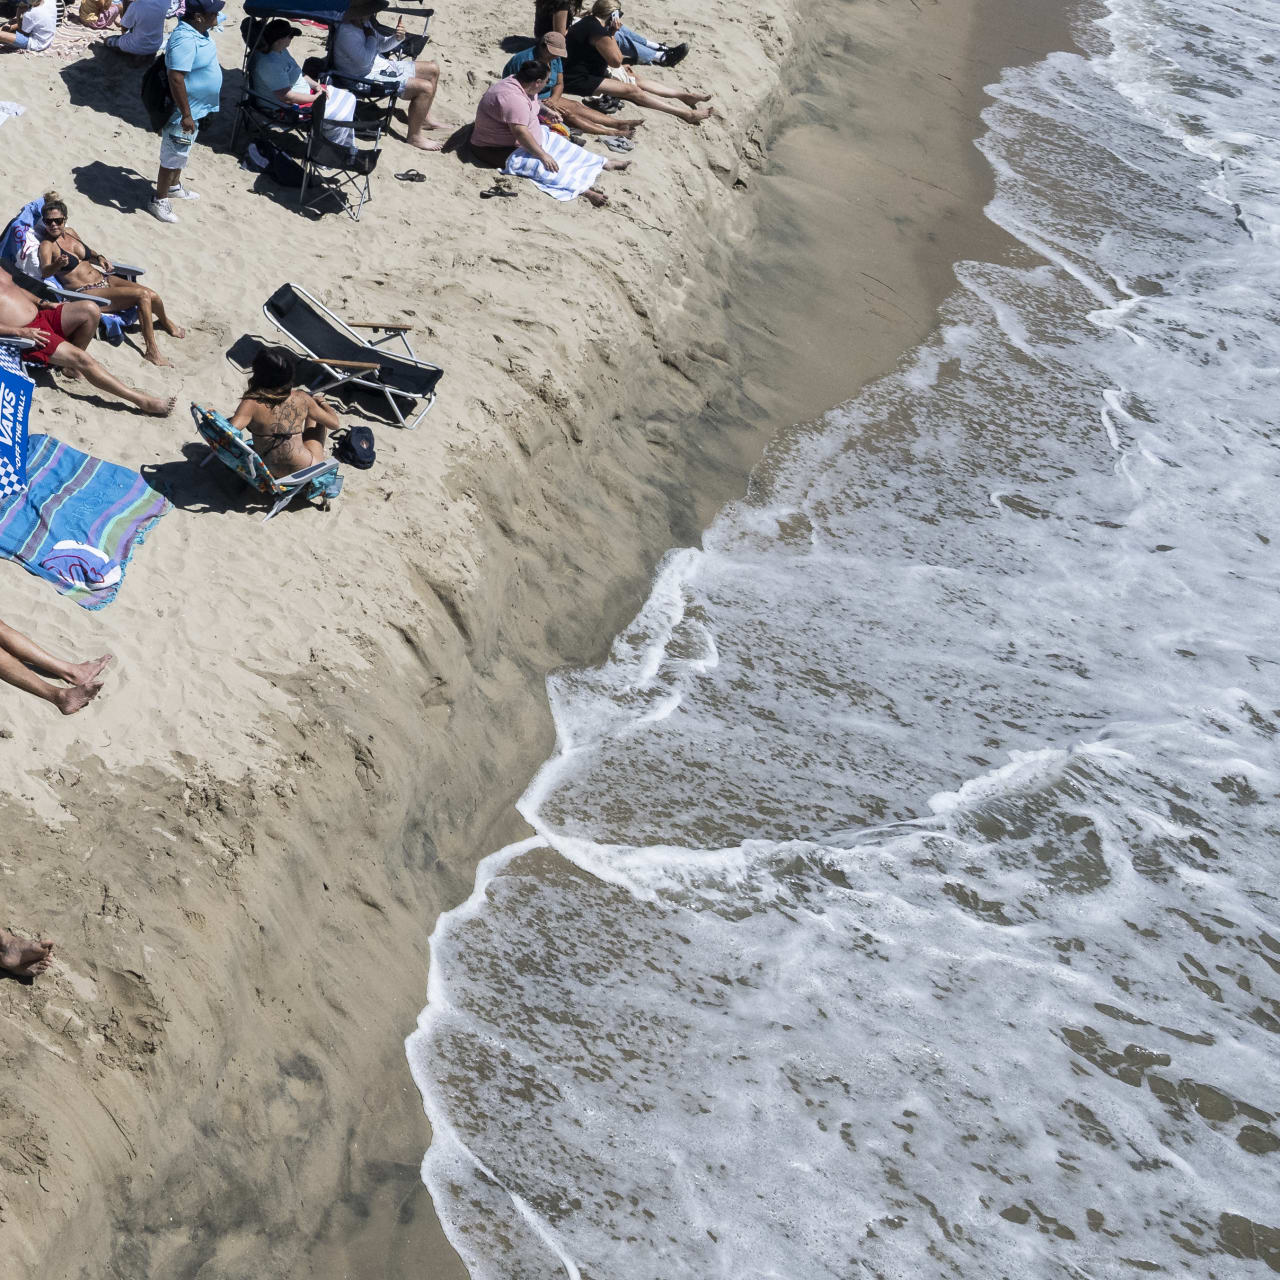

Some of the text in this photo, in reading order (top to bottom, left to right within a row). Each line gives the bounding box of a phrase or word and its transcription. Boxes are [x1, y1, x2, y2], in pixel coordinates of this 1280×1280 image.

[14, 390, 27, 470] "OFF THE WALL"
